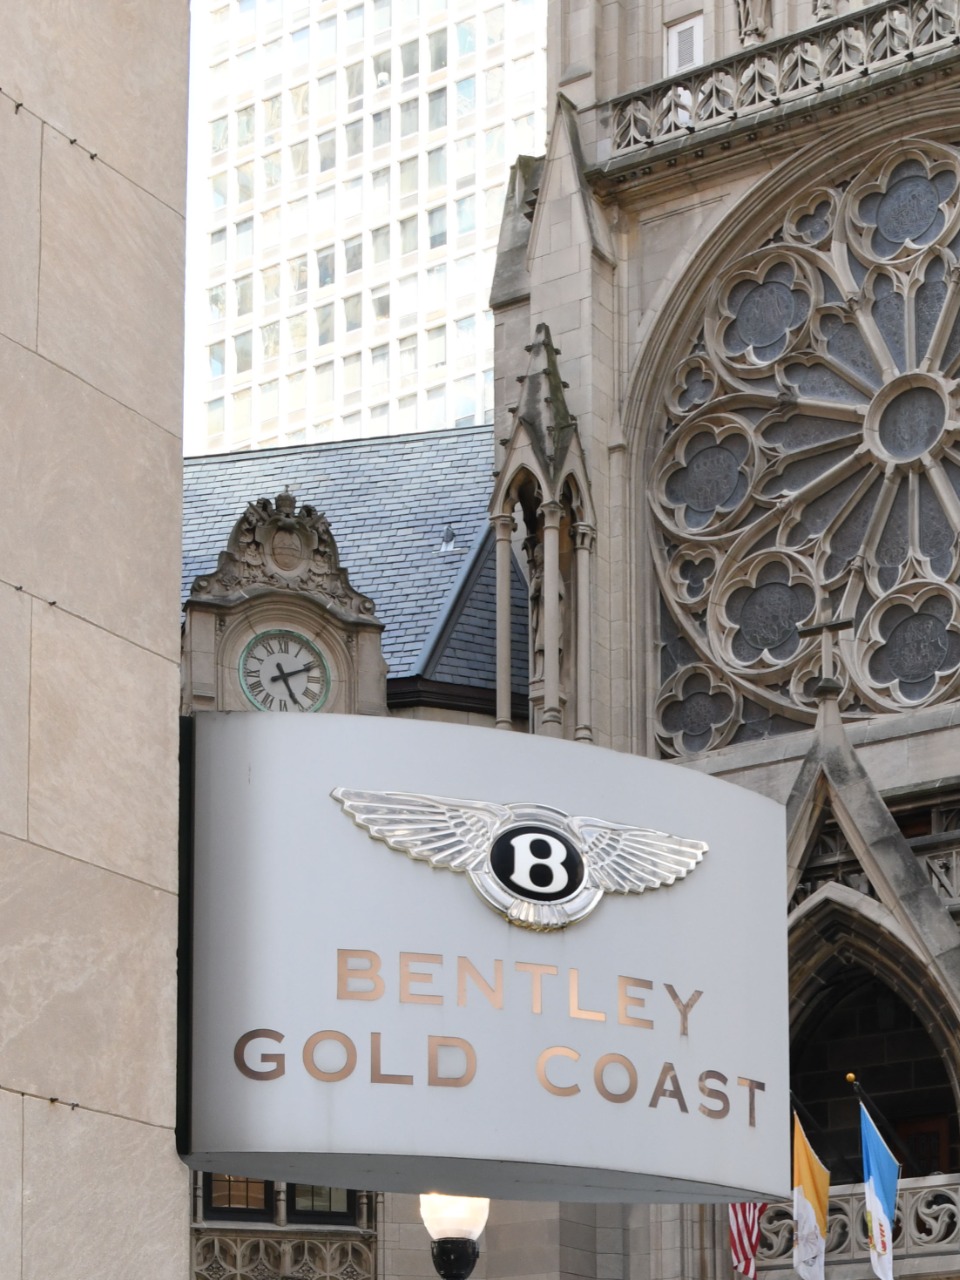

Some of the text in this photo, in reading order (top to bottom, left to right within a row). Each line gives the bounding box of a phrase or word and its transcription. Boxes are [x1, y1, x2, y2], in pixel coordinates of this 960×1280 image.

[509, 832, 569, 894] B
[337, 948, 704, 1037] BENTLEY
[233, 1028, 766, 1128] GOLD COAST
